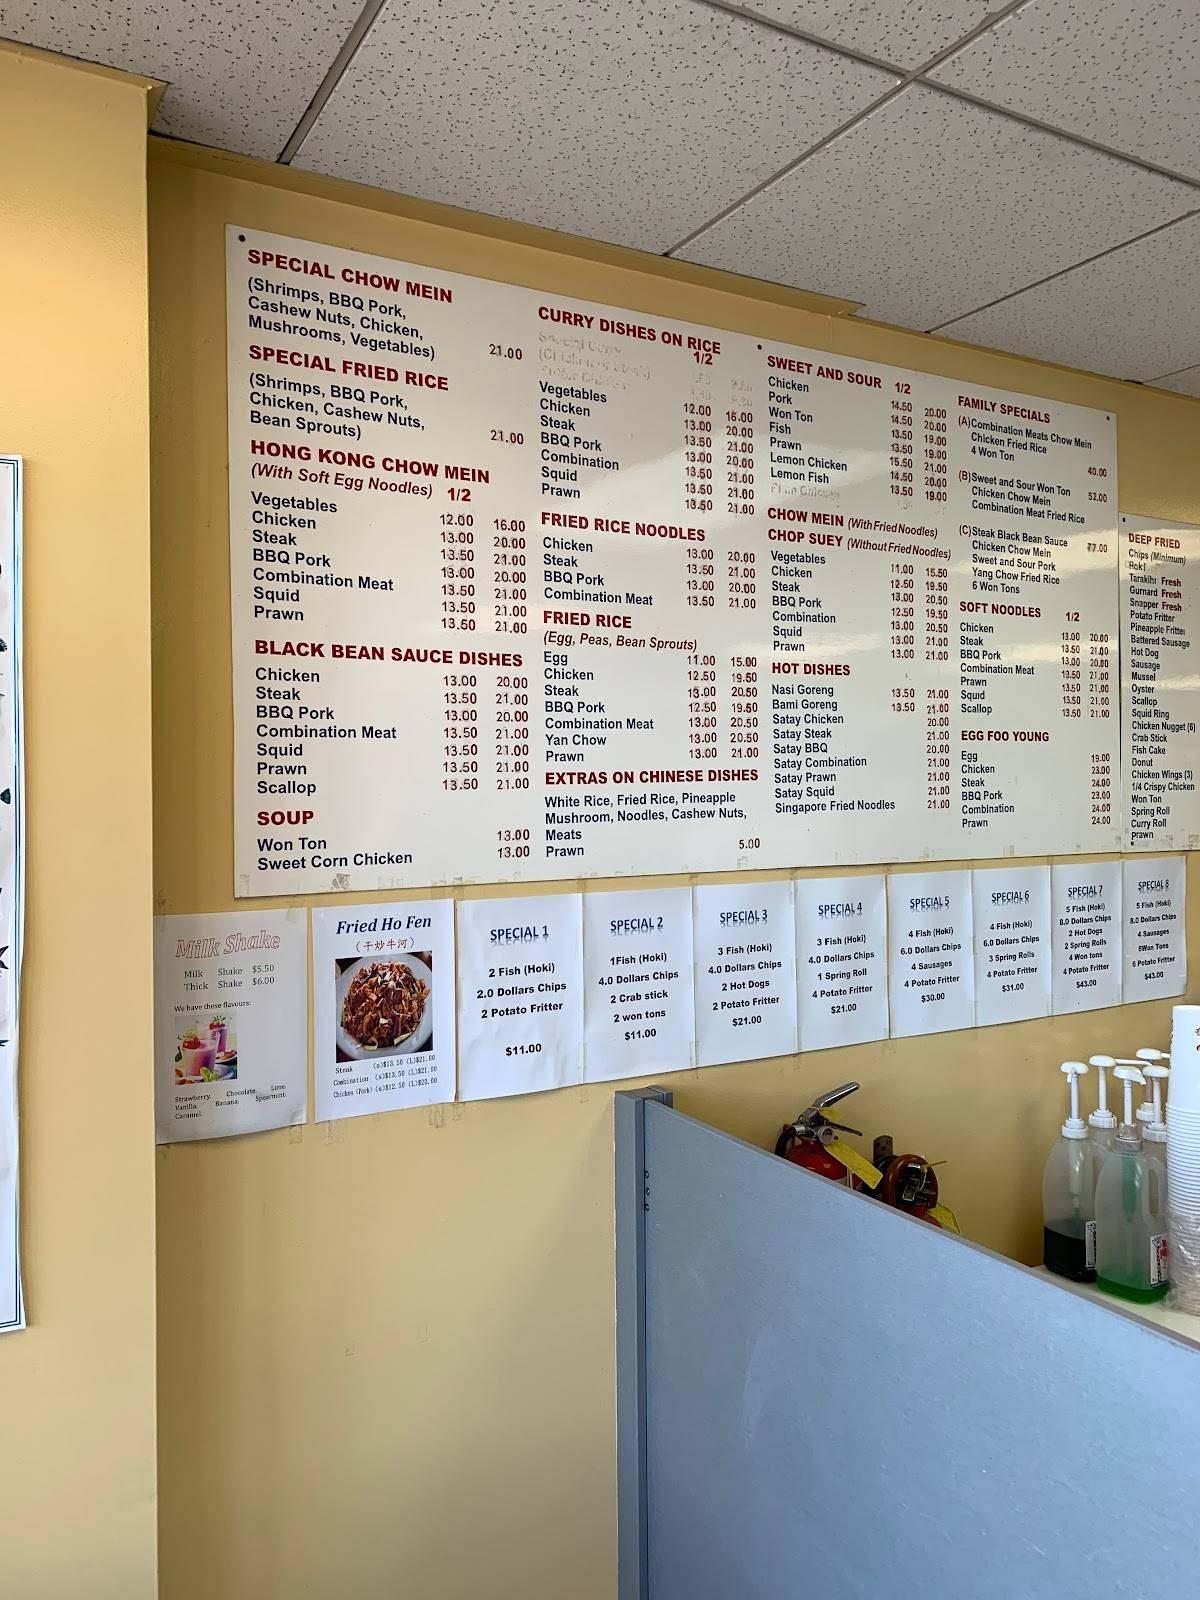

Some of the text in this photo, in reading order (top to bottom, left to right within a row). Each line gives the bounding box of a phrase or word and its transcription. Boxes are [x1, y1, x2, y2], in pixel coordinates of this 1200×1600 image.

[247, 249, 453, 304] SPECIAL CHOW MEIN
[247, 276, 406, 321] (Shrimps, BBQ Pork,
[249, 314, 523, 362] Mushrooms, Vegetables) 21.00
[537, 306, 721, 355] CURRY DISHES ON RICE
[693, 351, 713, 366] 1/2
[767, 355, 911, 395] SWEET AND SOUR 1/2
[538, 380, 607, 403] Vegetables
[957, 395, 1051, 424] FAMILY SPECIALS
[251, 439, 490, 484] HONG KONG CHOW MEIN
[770, 451, 848, 472] Lemon Chicken
[1087, 466, 1107, 478] 40.00
[251, 462, 471, 503] (With Soft Egg Noodles) 1/2
[250, 490, 526, 533] Vegetables 12.00 16.00
[971, 499, 1085, 524] Combination Meat Fried Rice
[541, 511, 706, 542] FRIED RICE NOODLES
[767, 507, 938, 541] CHOW MEIN (With Fried Noodles)
[767, 528, 843, 547] CHOP SUEY
[1128, 532, 1181, 549] DEEP FRIED
[1129, 585, 1182, 599] Gurnard Fresh
[543, 610, 632, 629] FRIED RICE
[959, 600, 1080, 622] SOFT NOODLES 1/2
[543, 630, 697, 653] (Egg, Peas, Bean Sprouts)
[1130, 634, 1191, 650] Battered Sausage
[255, 639, 523, 667] BLACK BEAN SAUCE DISHES
[771, 661, 851, 676] HOT DISHES
[771, 683, 949, 699] Nasi Goreng 13.50 21.00
[1131, 720, 1160, 731] Chicken
[1161, 721, 1186, 733] Nugget
[545, 731, 759, 746] Yan Chow 13.00 20.50
[961, 729, 1050, 742] EGG FOO YOUNG
[545, 769, 759, 785] EXTRAS ON CHINESE DISHES
[961, 763, 1111, 775] Chicken 23.00
[257, 777, 530, 797] Scallop 13.50 21.00
[544, 791, 736, 808] White Rice, Fried Rice, Pineapple
[775, 798, 950, 815] Singapore Fried Noodles 21.00
[257, 810, 314, 826] SOUP
[1131, 806, 1171, 818] Spring Roll
[256, 828, 530, 852] Won Ton 13.00
[545, 837, 761, 858] Prawn 5.00
[257, 851, 413, 871] Sweet Corn Chicken
[1138, 879, 1170, 891] SPECIAL 8
[991, 890, 1030, 903] SPECIAL 6
[720, 909, 768, 924] SPECIAL 3
[818, 902, 863, 916] SPECIAL 4
[335, 915, 432, 935] Fried Ho Fen
[490, 925, 549, 941] SPECIAL 1
[610, 917, 664, 932] SPECIAL 2
[176, 930, 281, 959] Milk Shake
[184, 963, 275, 979] Milk Shake $5.50
[488, 962, 555, 978] 2 Fish (Hoki)
[817, 967, 867, 982] 1 Spring Roll
[1144, 971, 1164, 981] $43.00
[476, 982, 567, 999] 2.0 Dollars Chips
[1001, 982, 1025, 993] $31.00
[732, 1015, 762, 1027] $21.00
[505, 1043, 542, 1057] $11.00
